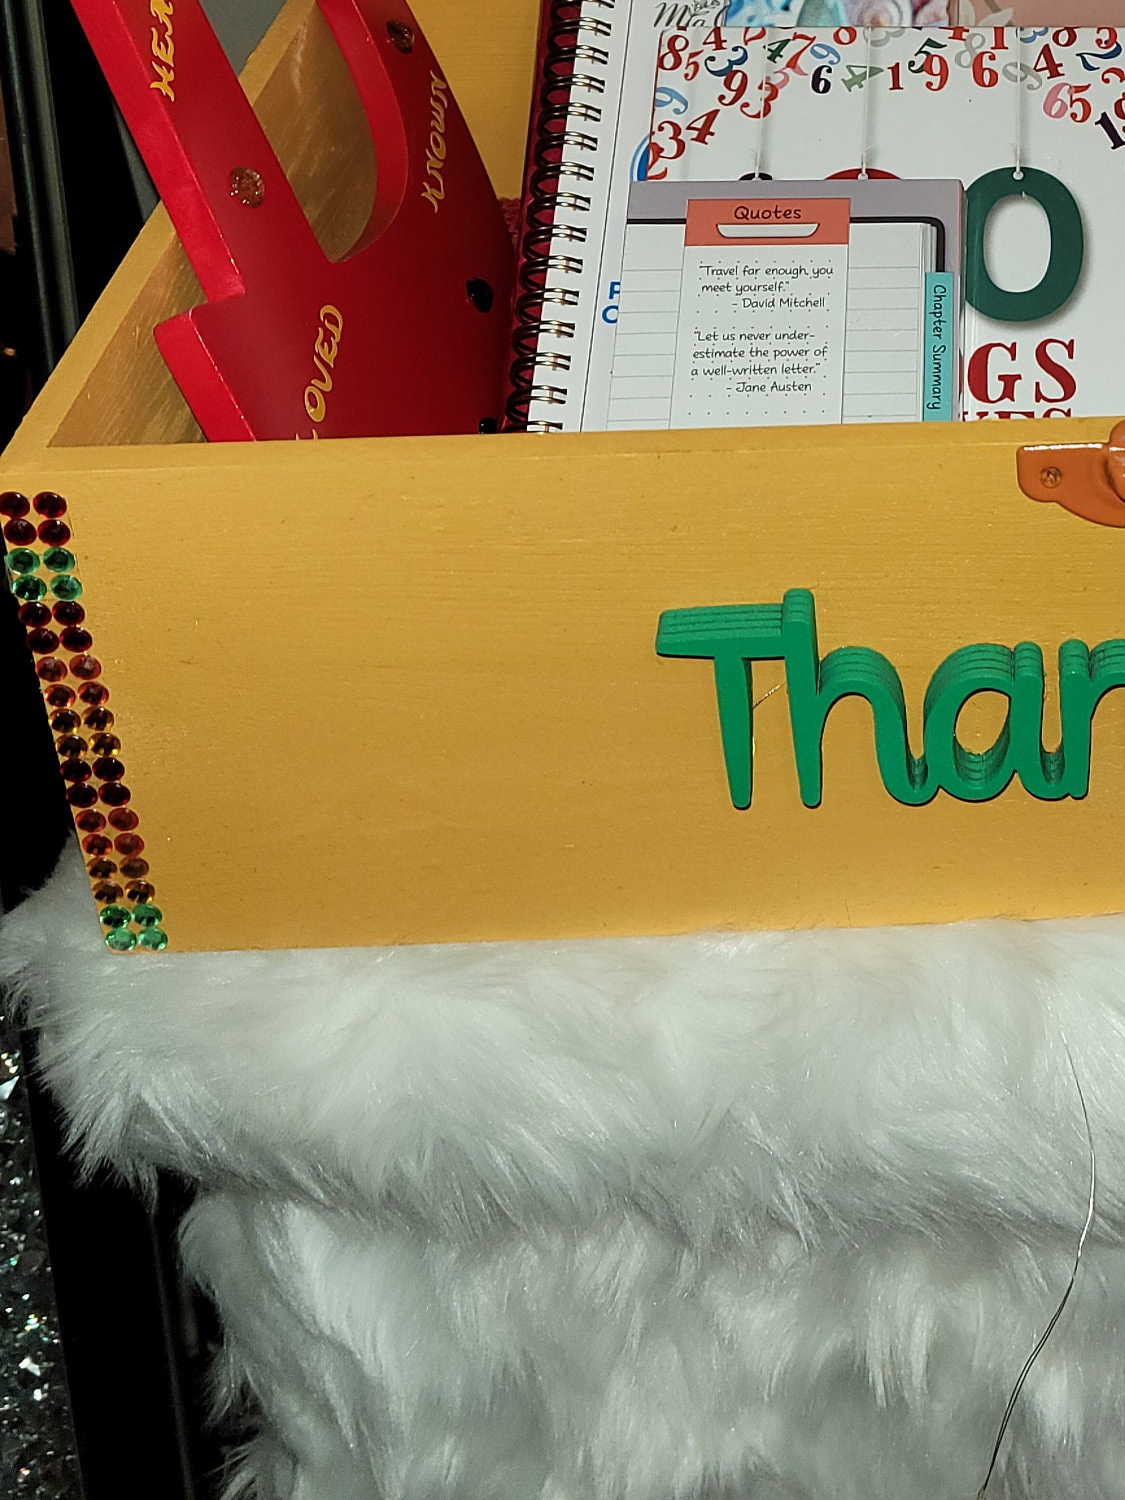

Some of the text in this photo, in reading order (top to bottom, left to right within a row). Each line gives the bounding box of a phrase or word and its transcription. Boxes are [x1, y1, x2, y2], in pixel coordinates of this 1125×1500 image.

[658, 35, 689, 70] 8
[1033, 43, 1065, 80] 4
[811, 65, 833, 94] 6
[887, 62, 904, 91] 1
[924, 54, 949, 91] 9
[971, 51, 999, 88] 6
[421, 70, 447, 214] KNOWN
[733, 205, 802, 221] Quotes
[742, 265, 761, 277] far
[812, 266, 834, 278] you
[701, 282, 732, 293] meet
[742, 297, 826, 309] David Mitchell
[722, 331, 736, 341] us
[739, 331, 771, 341] never
[774, 331, 815, 341] under-
[926, 284, 947, 410] Chapter Summary
[692, 346, 828, 360] estimate the power of
[296, 305, 343, 440] OVED
[691, 366, 699, 376] a
[703, 364, 777, 376] well-written
[735, 380, 812, 393] Jane Austen
